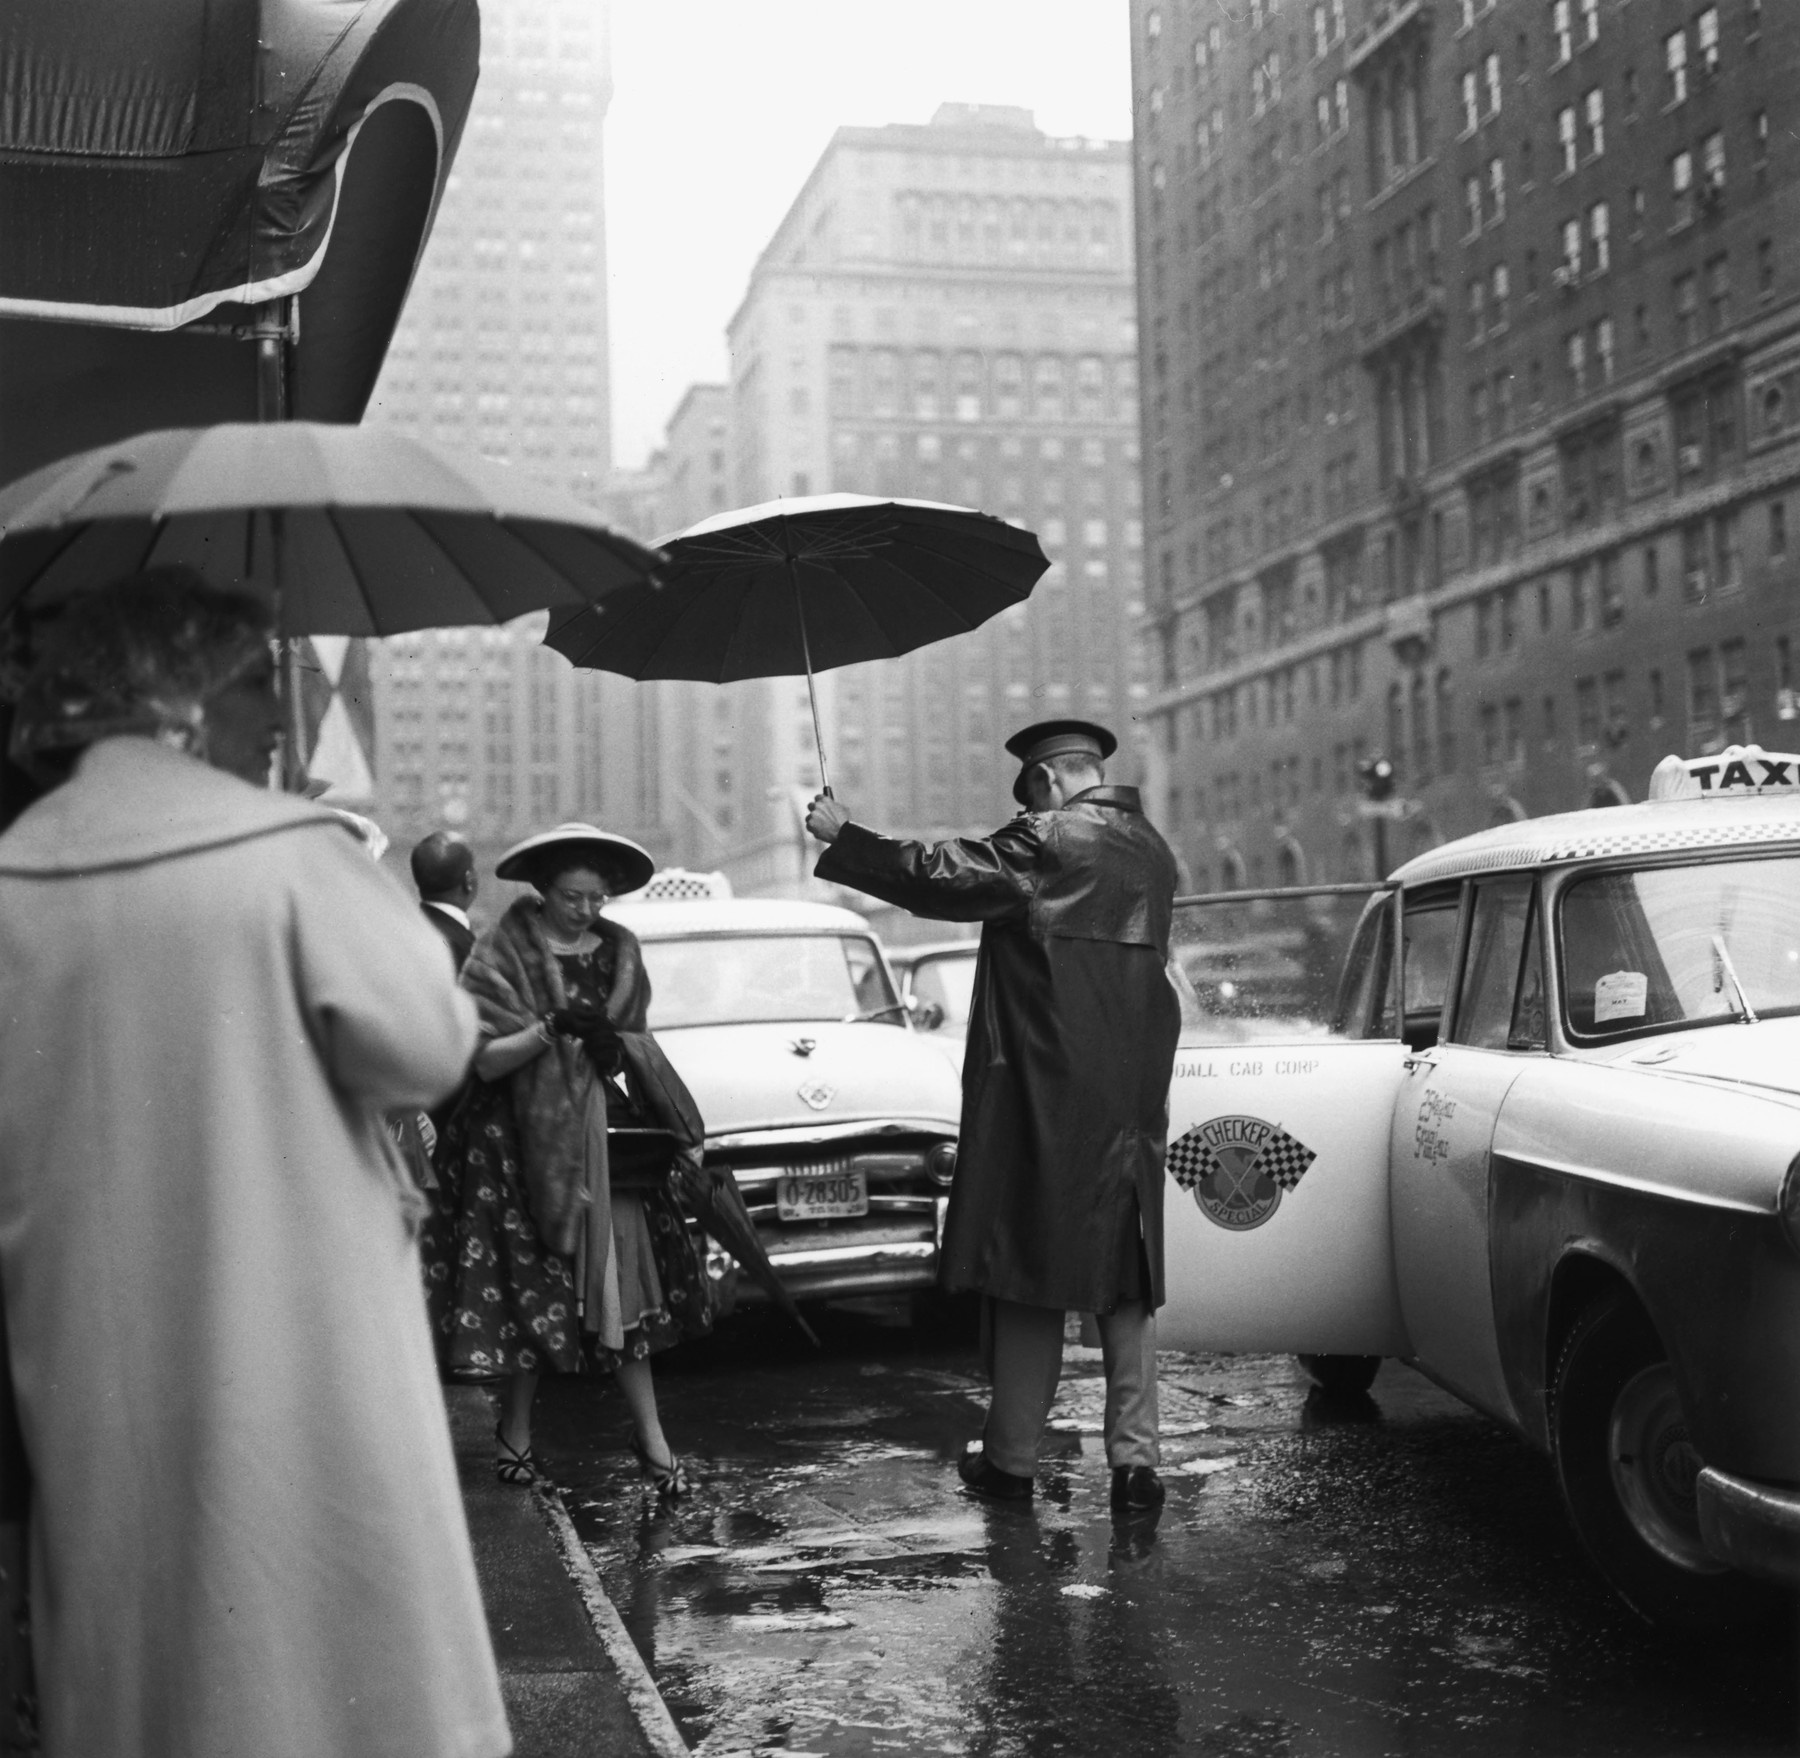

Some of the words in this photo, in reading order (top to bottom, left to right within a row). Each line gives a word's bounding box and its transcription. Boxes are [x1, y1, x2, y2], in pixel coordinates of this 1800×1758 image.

[1689, 759, 1800, 790] TAX
[1230, 1061, 1263, 1076] CAB
[1275, 1060, 1319, 1076] CORP
[1203, 1119, 1270, 1147] CHECKER
[1210, 1202, 1268, 1223] SPECIAL
